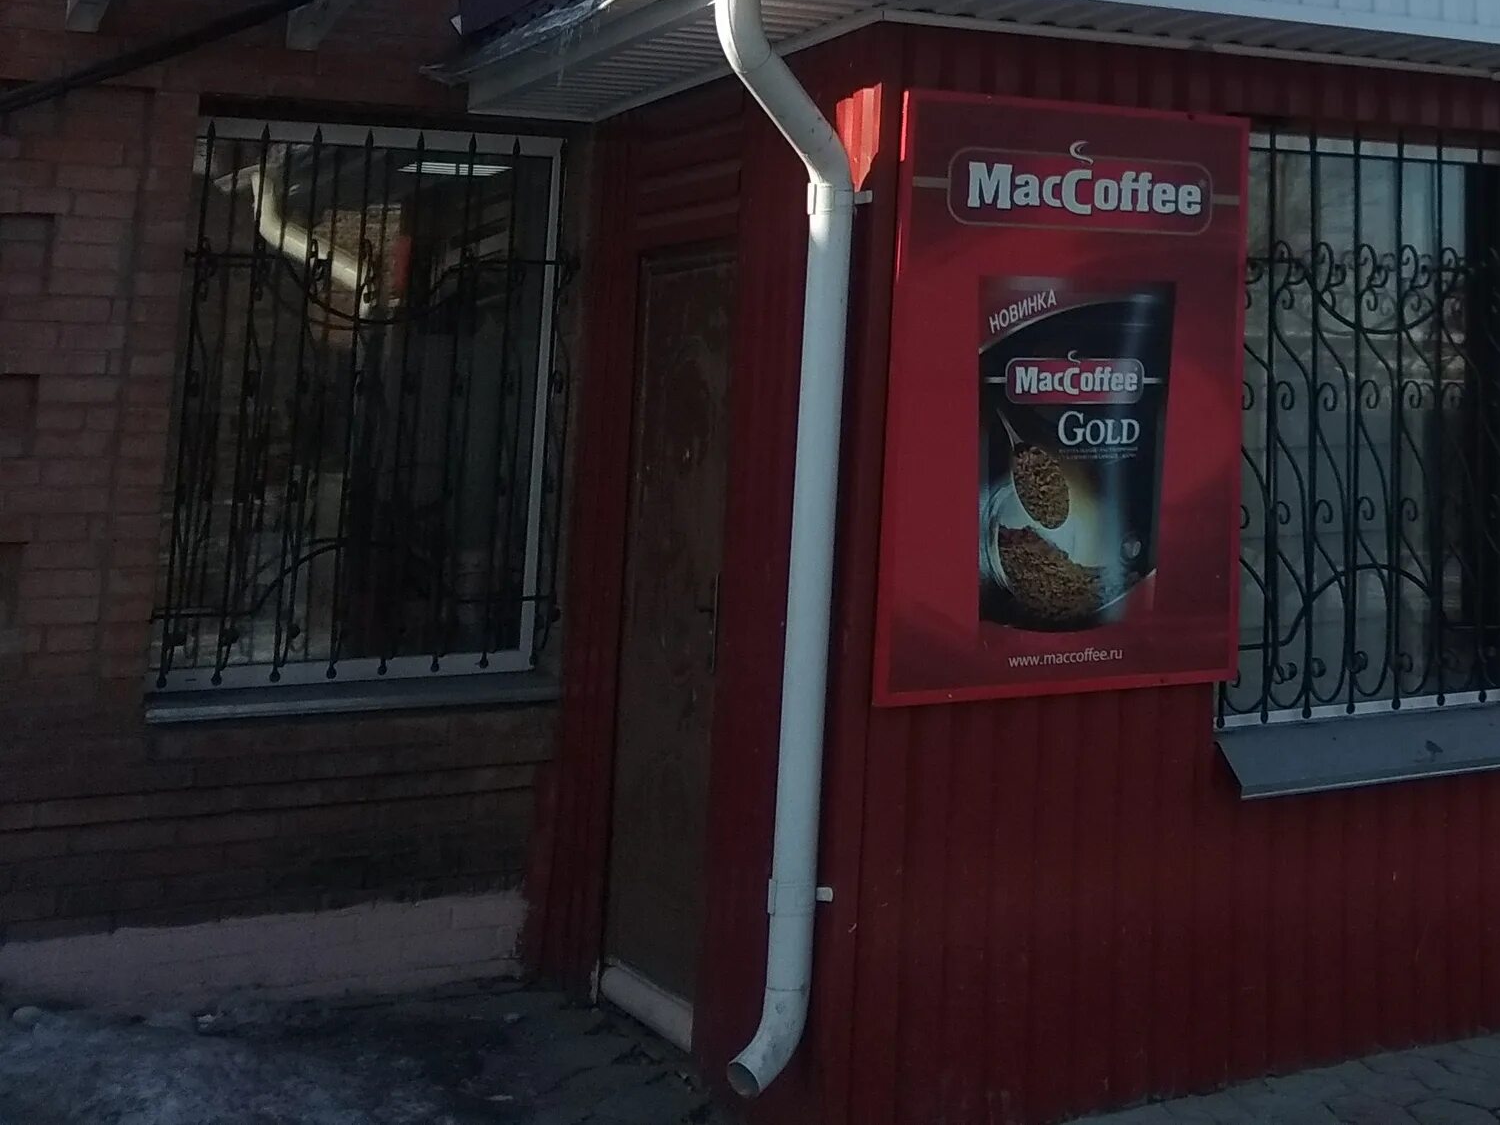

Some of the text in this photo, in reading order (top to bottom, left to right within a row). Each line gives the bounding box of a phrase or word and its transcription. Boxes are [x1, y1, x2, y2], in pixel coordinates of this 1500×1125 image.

[967, 161, 1203, 216] MacCoffee
[988, 289, 1058, 333] НОВИНКА
[1014, 364, 1138, 397] MacCoffee
[1008, 646, 1123, 668] www.maccoffee.ru
